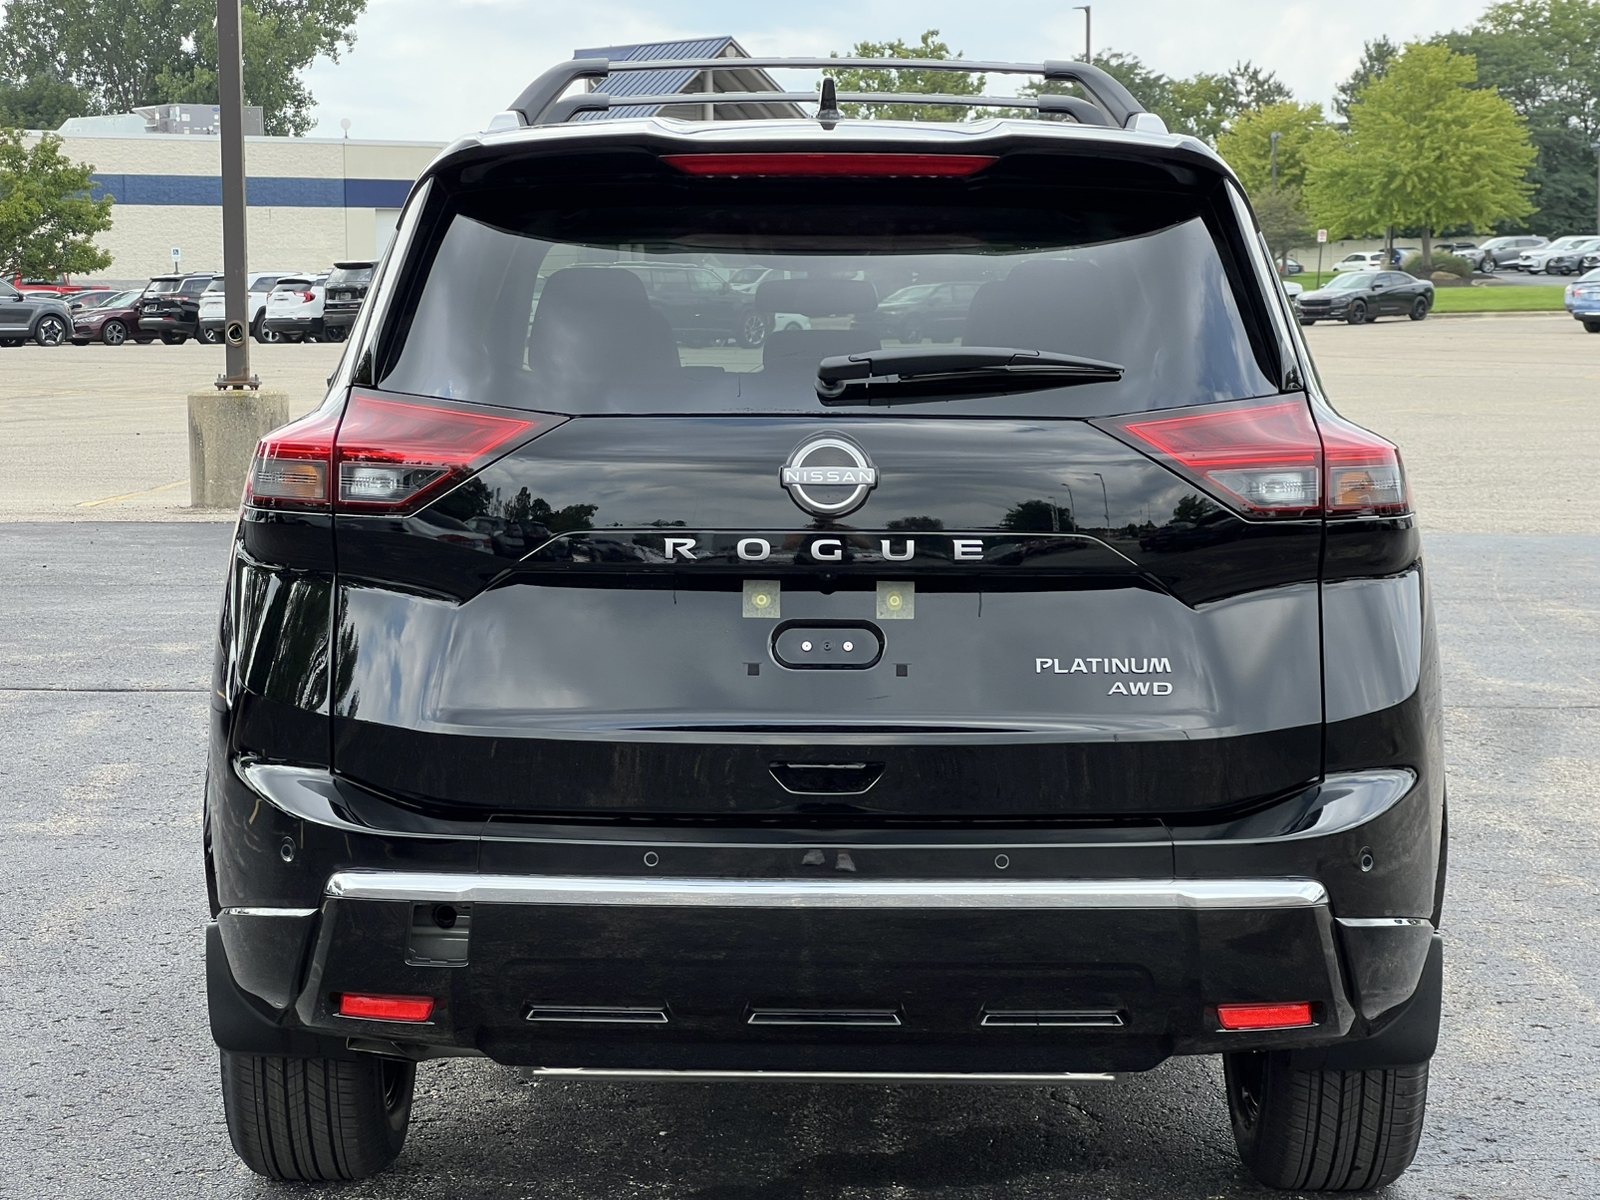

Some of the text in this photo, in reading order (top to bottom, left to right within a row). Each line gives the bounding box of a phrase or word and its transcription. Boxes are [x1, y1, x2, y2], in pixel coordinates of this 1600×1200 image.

[786, 471, 872, 482] NISSAN
[664, 538, 984, 561] ROGUE
[1035, 657, 1172, 674] PLATINUM
[1107, 681, 1174, 696] AWD
